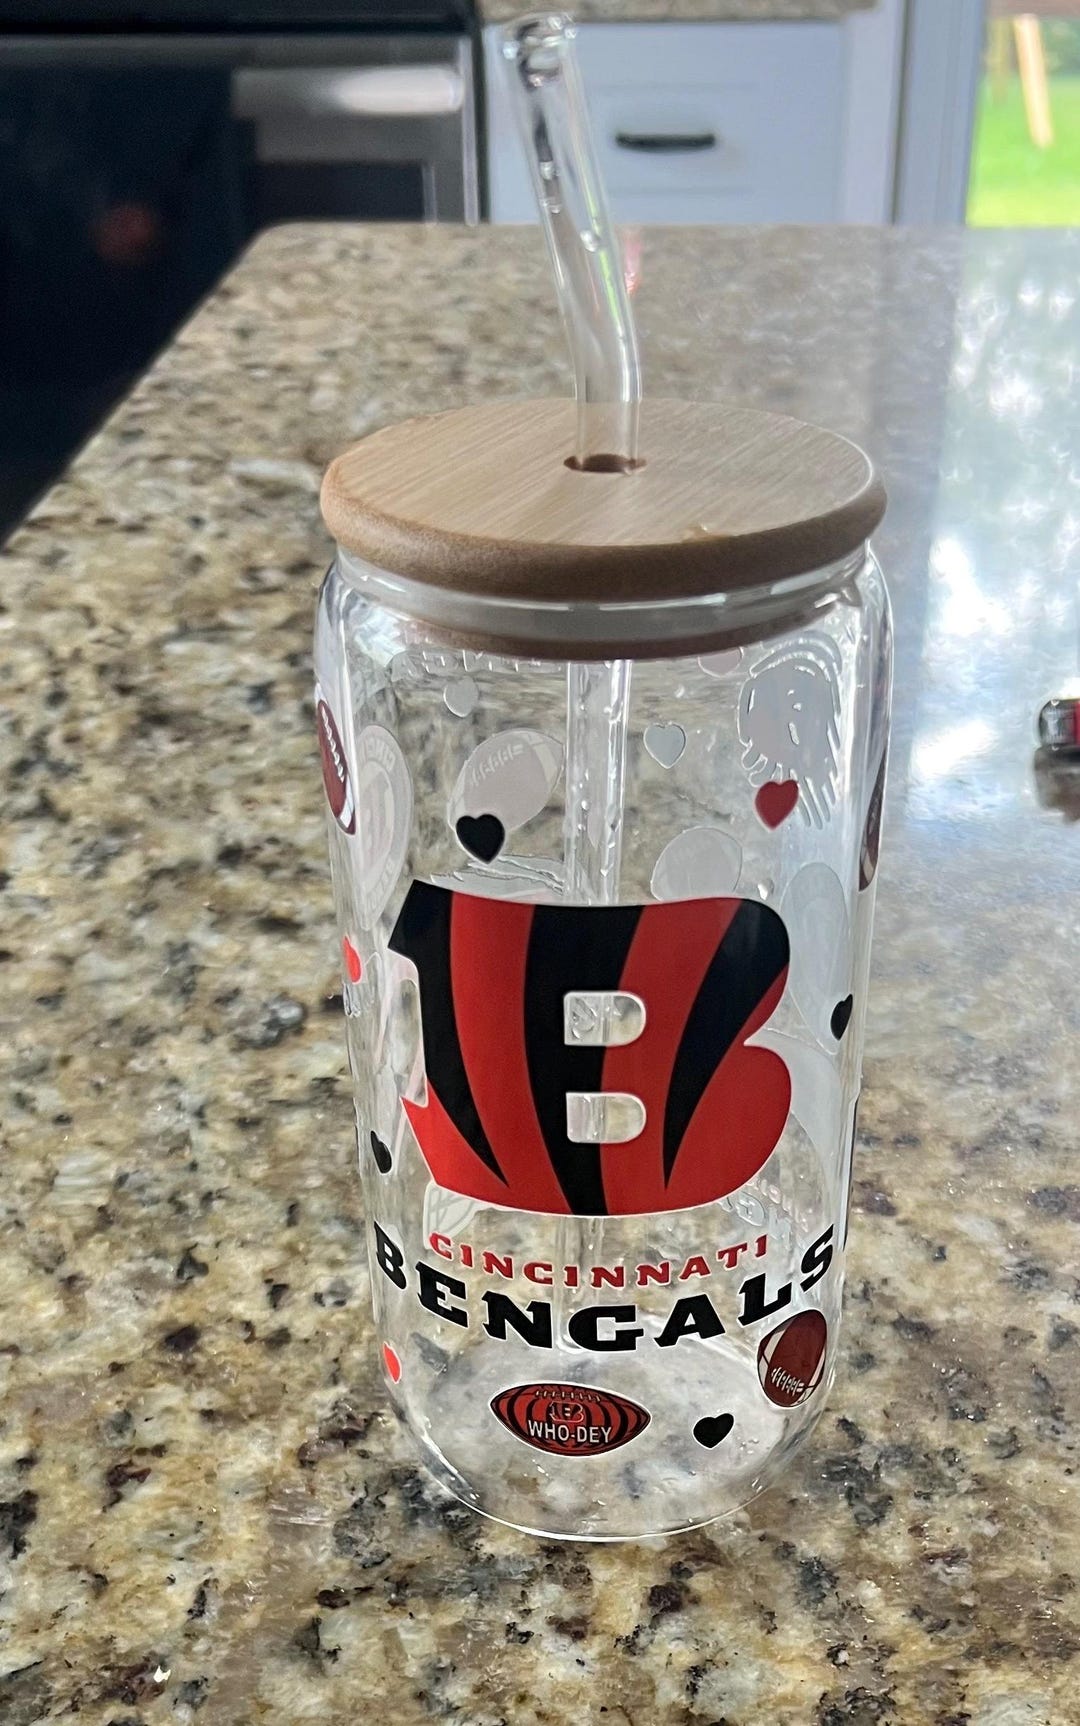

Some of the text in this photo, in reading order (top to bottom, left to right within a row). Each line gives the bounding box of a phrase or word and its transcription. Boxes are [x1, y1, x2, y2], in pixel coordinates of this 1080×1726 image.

[374, 1220, 834, 1352] BENGALS
[428, 1232, 768, 1288] CINCINNATI
[528, 1420, 612, 1443] WHO-DEY
